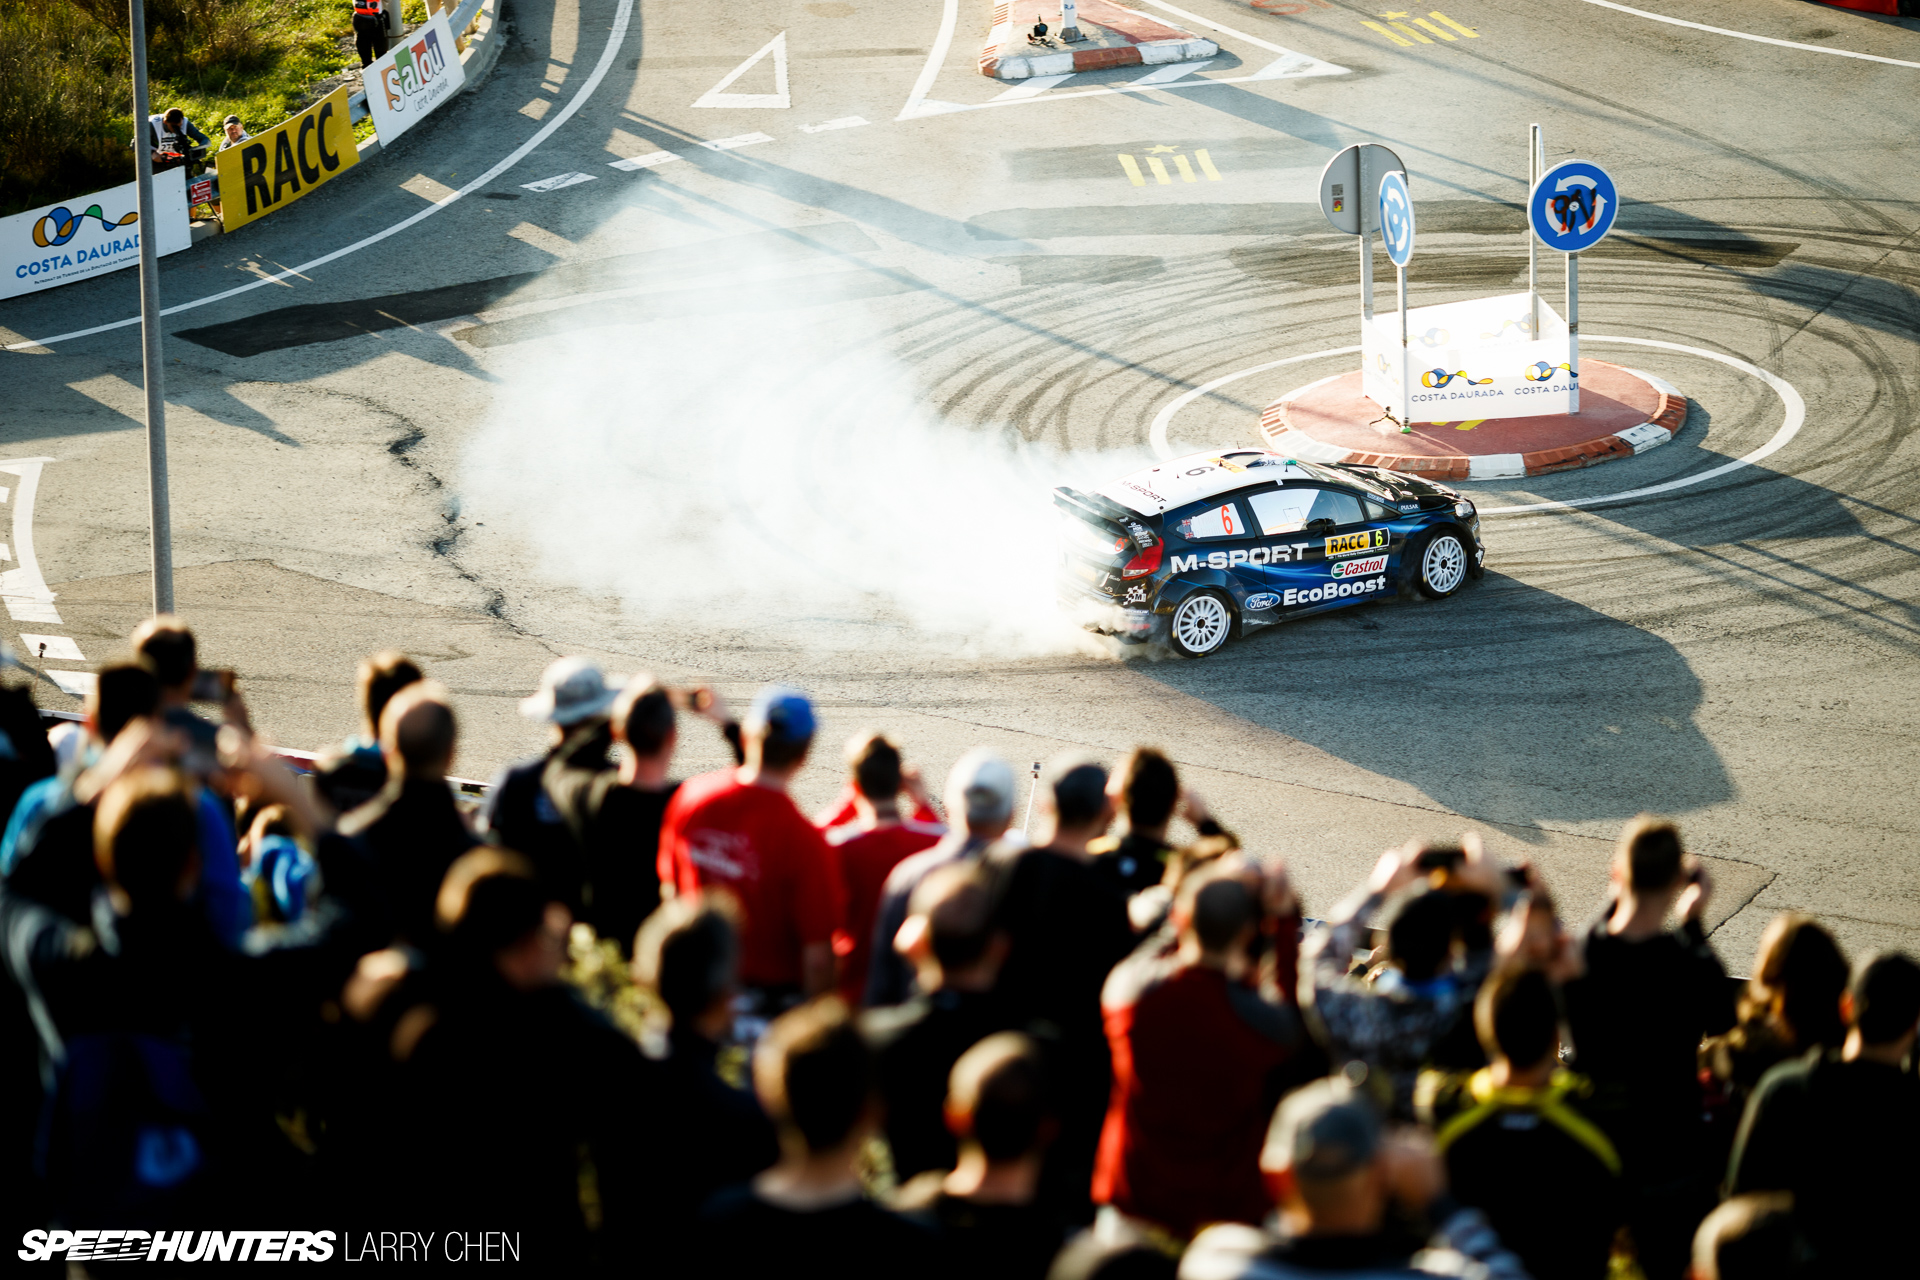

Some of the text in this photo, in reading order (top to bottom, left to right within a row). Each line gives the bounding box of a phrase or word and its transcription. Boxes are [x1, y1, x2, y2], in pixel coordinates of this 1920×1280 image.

[387, 41, 446, 112] Salou
[241, 102, 340, 216] RACC
[15, 234, 139, 279] COSTA DAURAD
[1411, 389, 1505, 403] COSTA DAURADA
[1514, 386, 1550, 396] COSTA
[1185, 466, 1215, 476] 6
[1221, 504, 1233, 535] 6
[1331, 530, 1383, 553] RACC 6
[1170, 542, 1310, 574] M-SPORT
[1345, 557, 1384, 575] Castrol
[1250, 594, 1274, 608] Ford
[1283, 574, 1386, 606] EcoBoost
